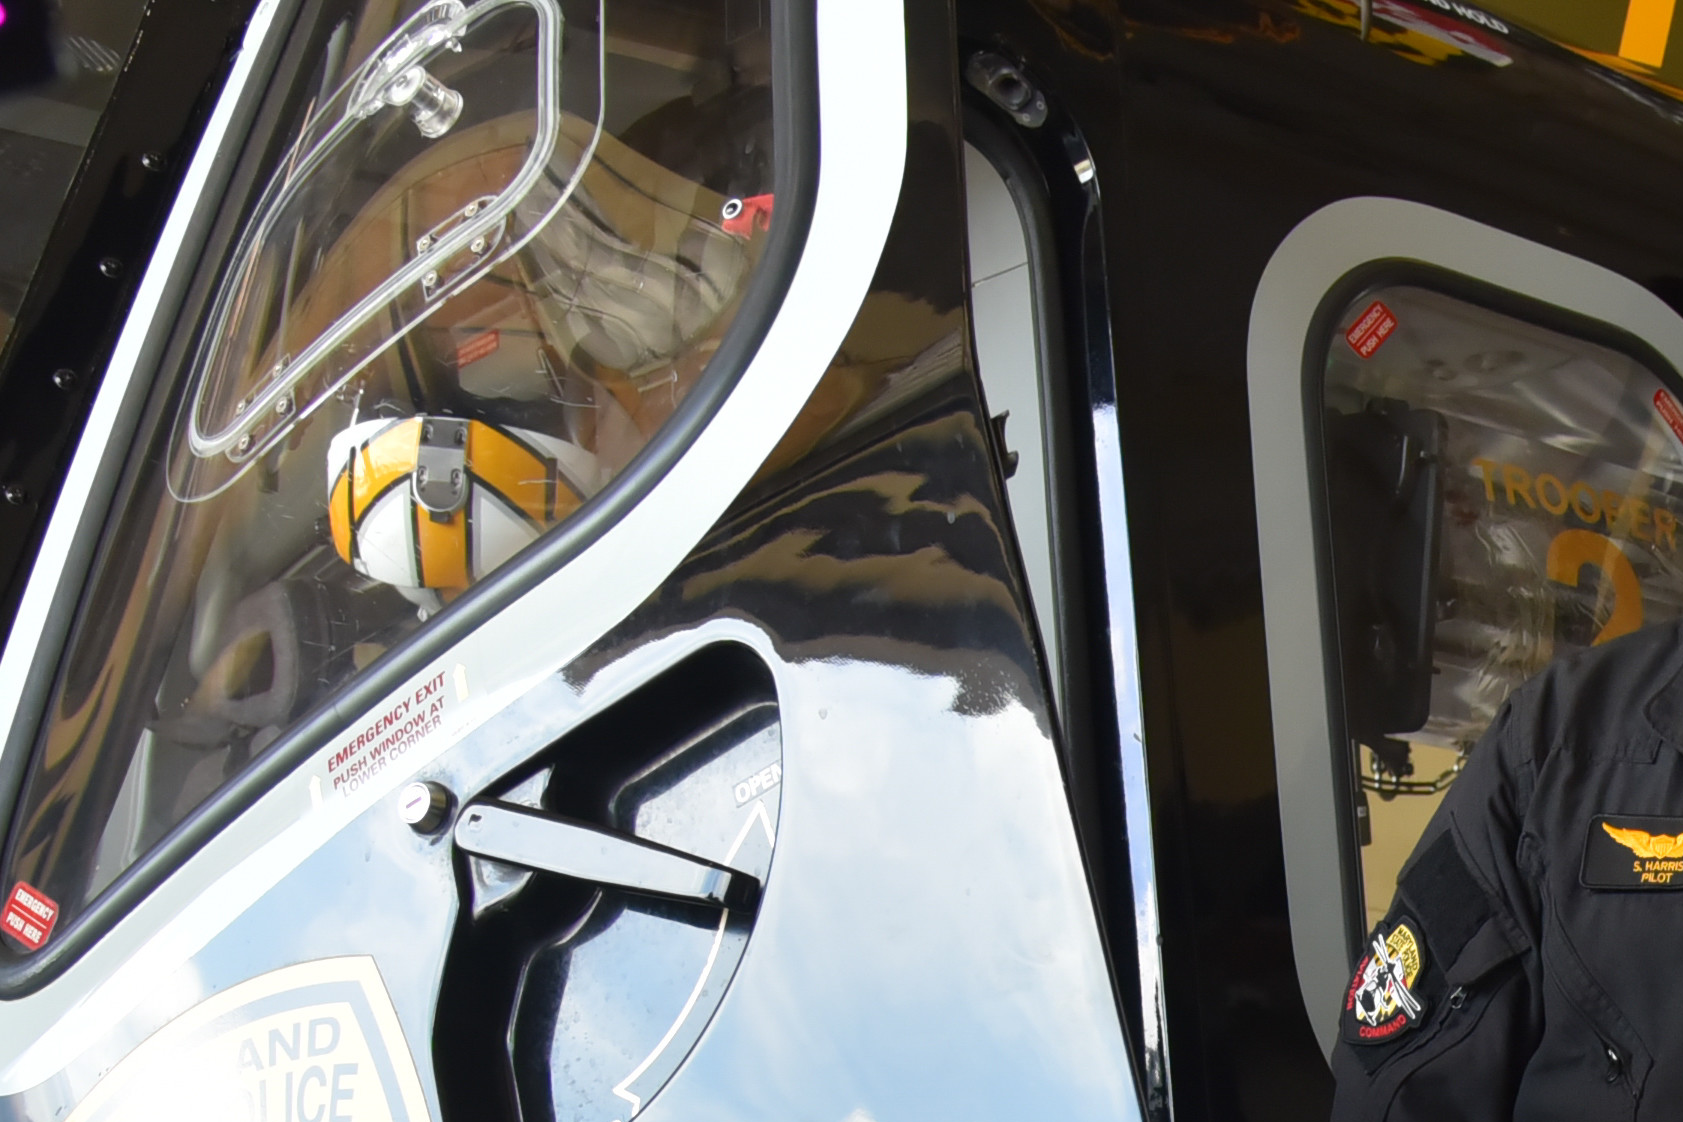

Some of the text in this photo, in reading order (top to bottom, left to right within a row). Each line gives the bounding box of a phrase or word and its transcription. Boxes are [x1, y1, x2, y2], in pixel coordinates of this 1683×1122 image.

[1453, 5, 1509, 34] HOLD
[1472, 457, 1678, 551] TROOPER
[1546, 528, 1644, 647] 2
[328, 671, 446, 773] EMERGENCY EXIT
[333, 695, 445, 790] PUSH WINDOW AT
[342, 714, 442, 798] LOWER CORNER
[735, 763, 782, 802] OPEN
[1633, 861, 1642, 872] S.
[1641, 873, 1673, 883] PILOT
[1359, 1014, 1407, 1038] COMMAND
